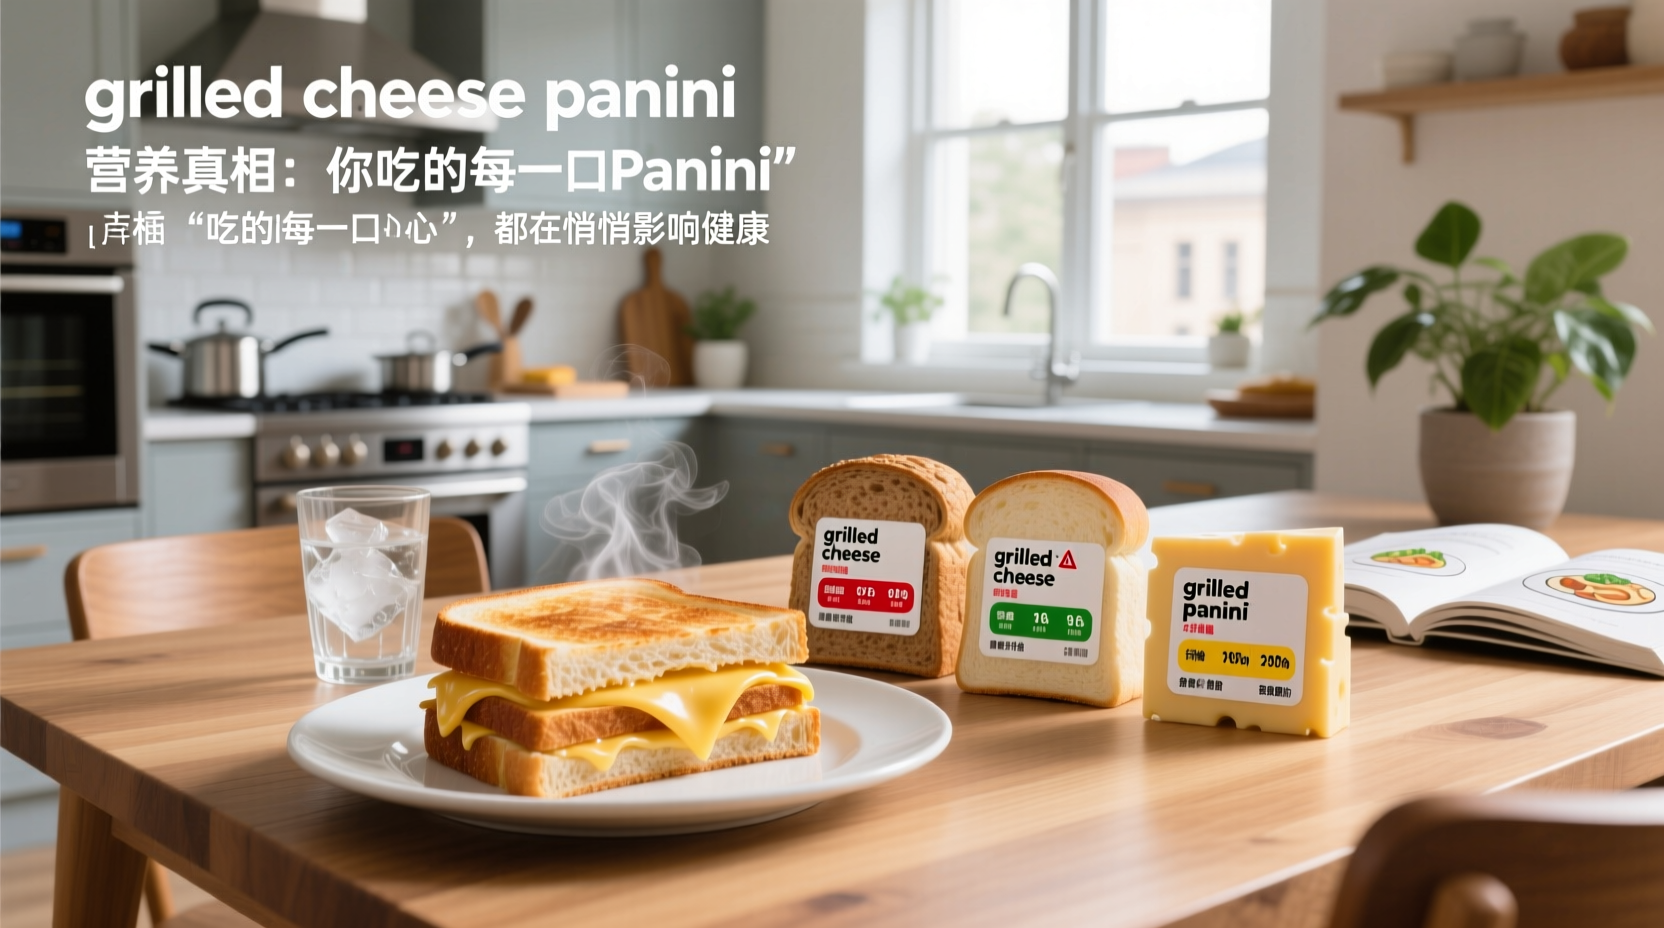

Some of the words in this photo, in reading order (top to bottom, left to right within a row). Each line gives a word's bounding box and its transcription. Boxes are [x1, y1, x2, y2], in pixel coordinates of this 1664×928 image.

[824, 526, 879, 547] grilled
[822, 544, 881, 562] cheese
[994, 547, 1053, 568] grilled
[993, 567, 1056, 586] cheese
[1183, 578, 1250, 601] grilled
[1182, 601, 1250, 622] panini
